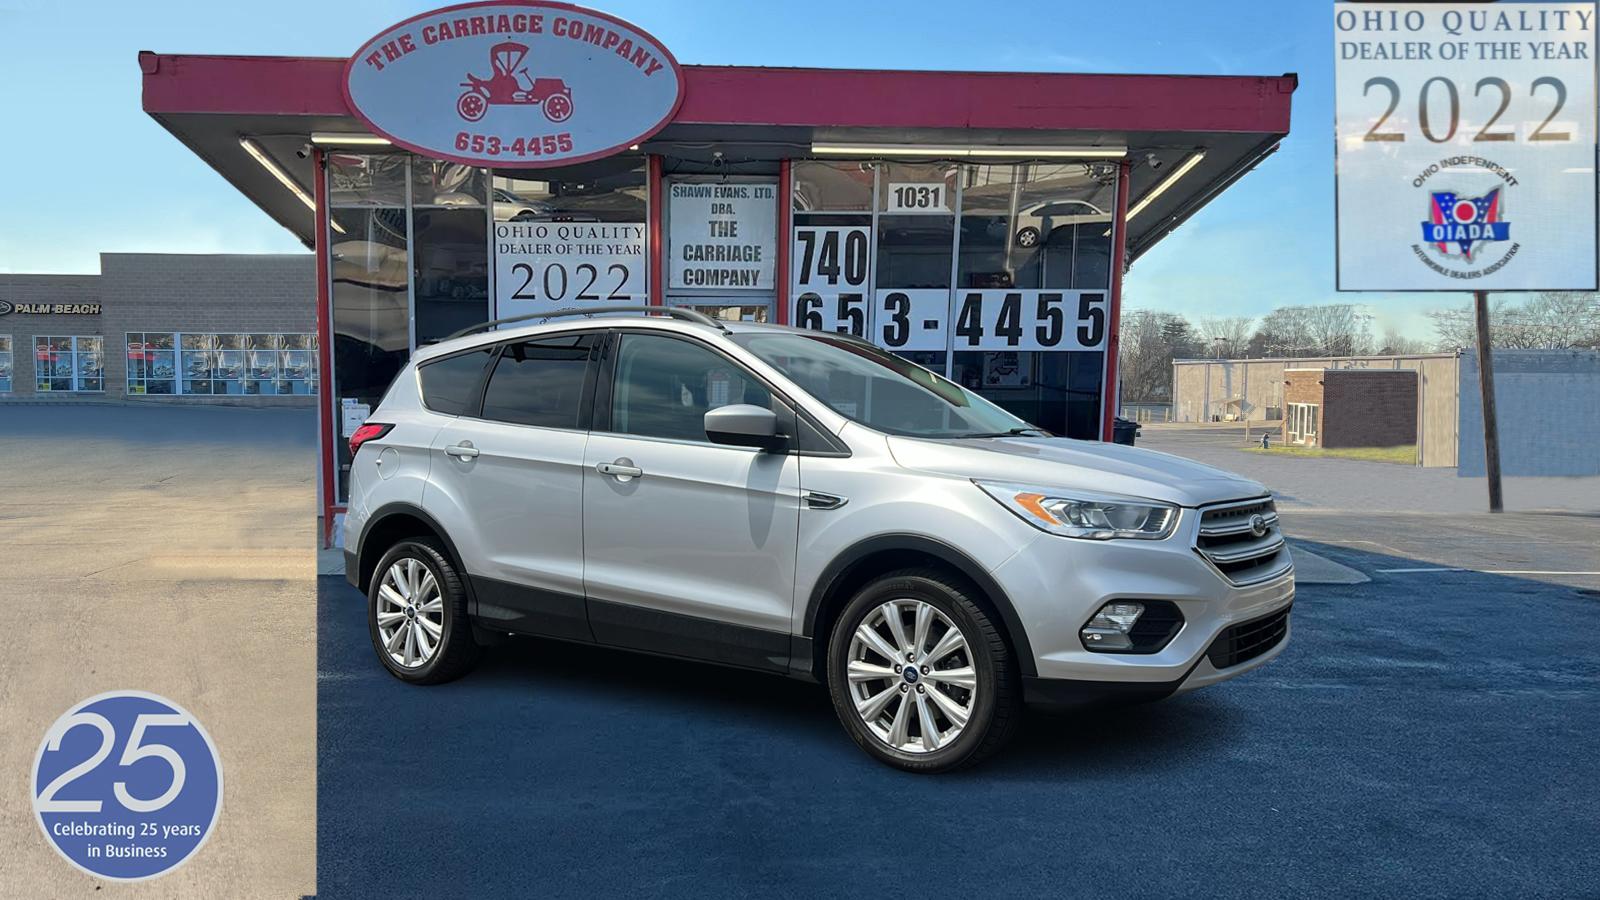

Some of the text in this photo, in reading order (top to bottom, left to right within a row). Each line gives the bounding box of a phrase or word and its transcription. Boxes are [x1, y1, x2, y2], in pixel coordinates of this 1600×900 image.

[1336, 10, 1593, 35] OHIO QUALITY
[365, 14, 663, 77] THE CARRIAGE COMPANY
[1340, 42, 1589, 60] DEALER OF THE YEAR
[1363, 76, 1571, 143] 2022
[455, 132, 573, 156] 653-4455
[1412, 156, 1519, 188] OHIO INDEPENDENT
[672, 186, 712, 198] SHAWN
[895, 186, 940, 208] 1031
[711, 204, 736, 215] DBA.
[497, 226, 644, 240] OHIO QUALITY
[708, 221, 738, 237] THE
[1432, 223, 1495, 240] OIADA
[499, 244, 641, 255] DEALER OF THE YEAR
[683, 244, 762, 262] CARRIAGE
[797, 230, 868, 286] 740
[511, 263, 631, 300] 2022
[683, 269, 761, 286] COMPANY
[14, 303, 51, 314] PALM
